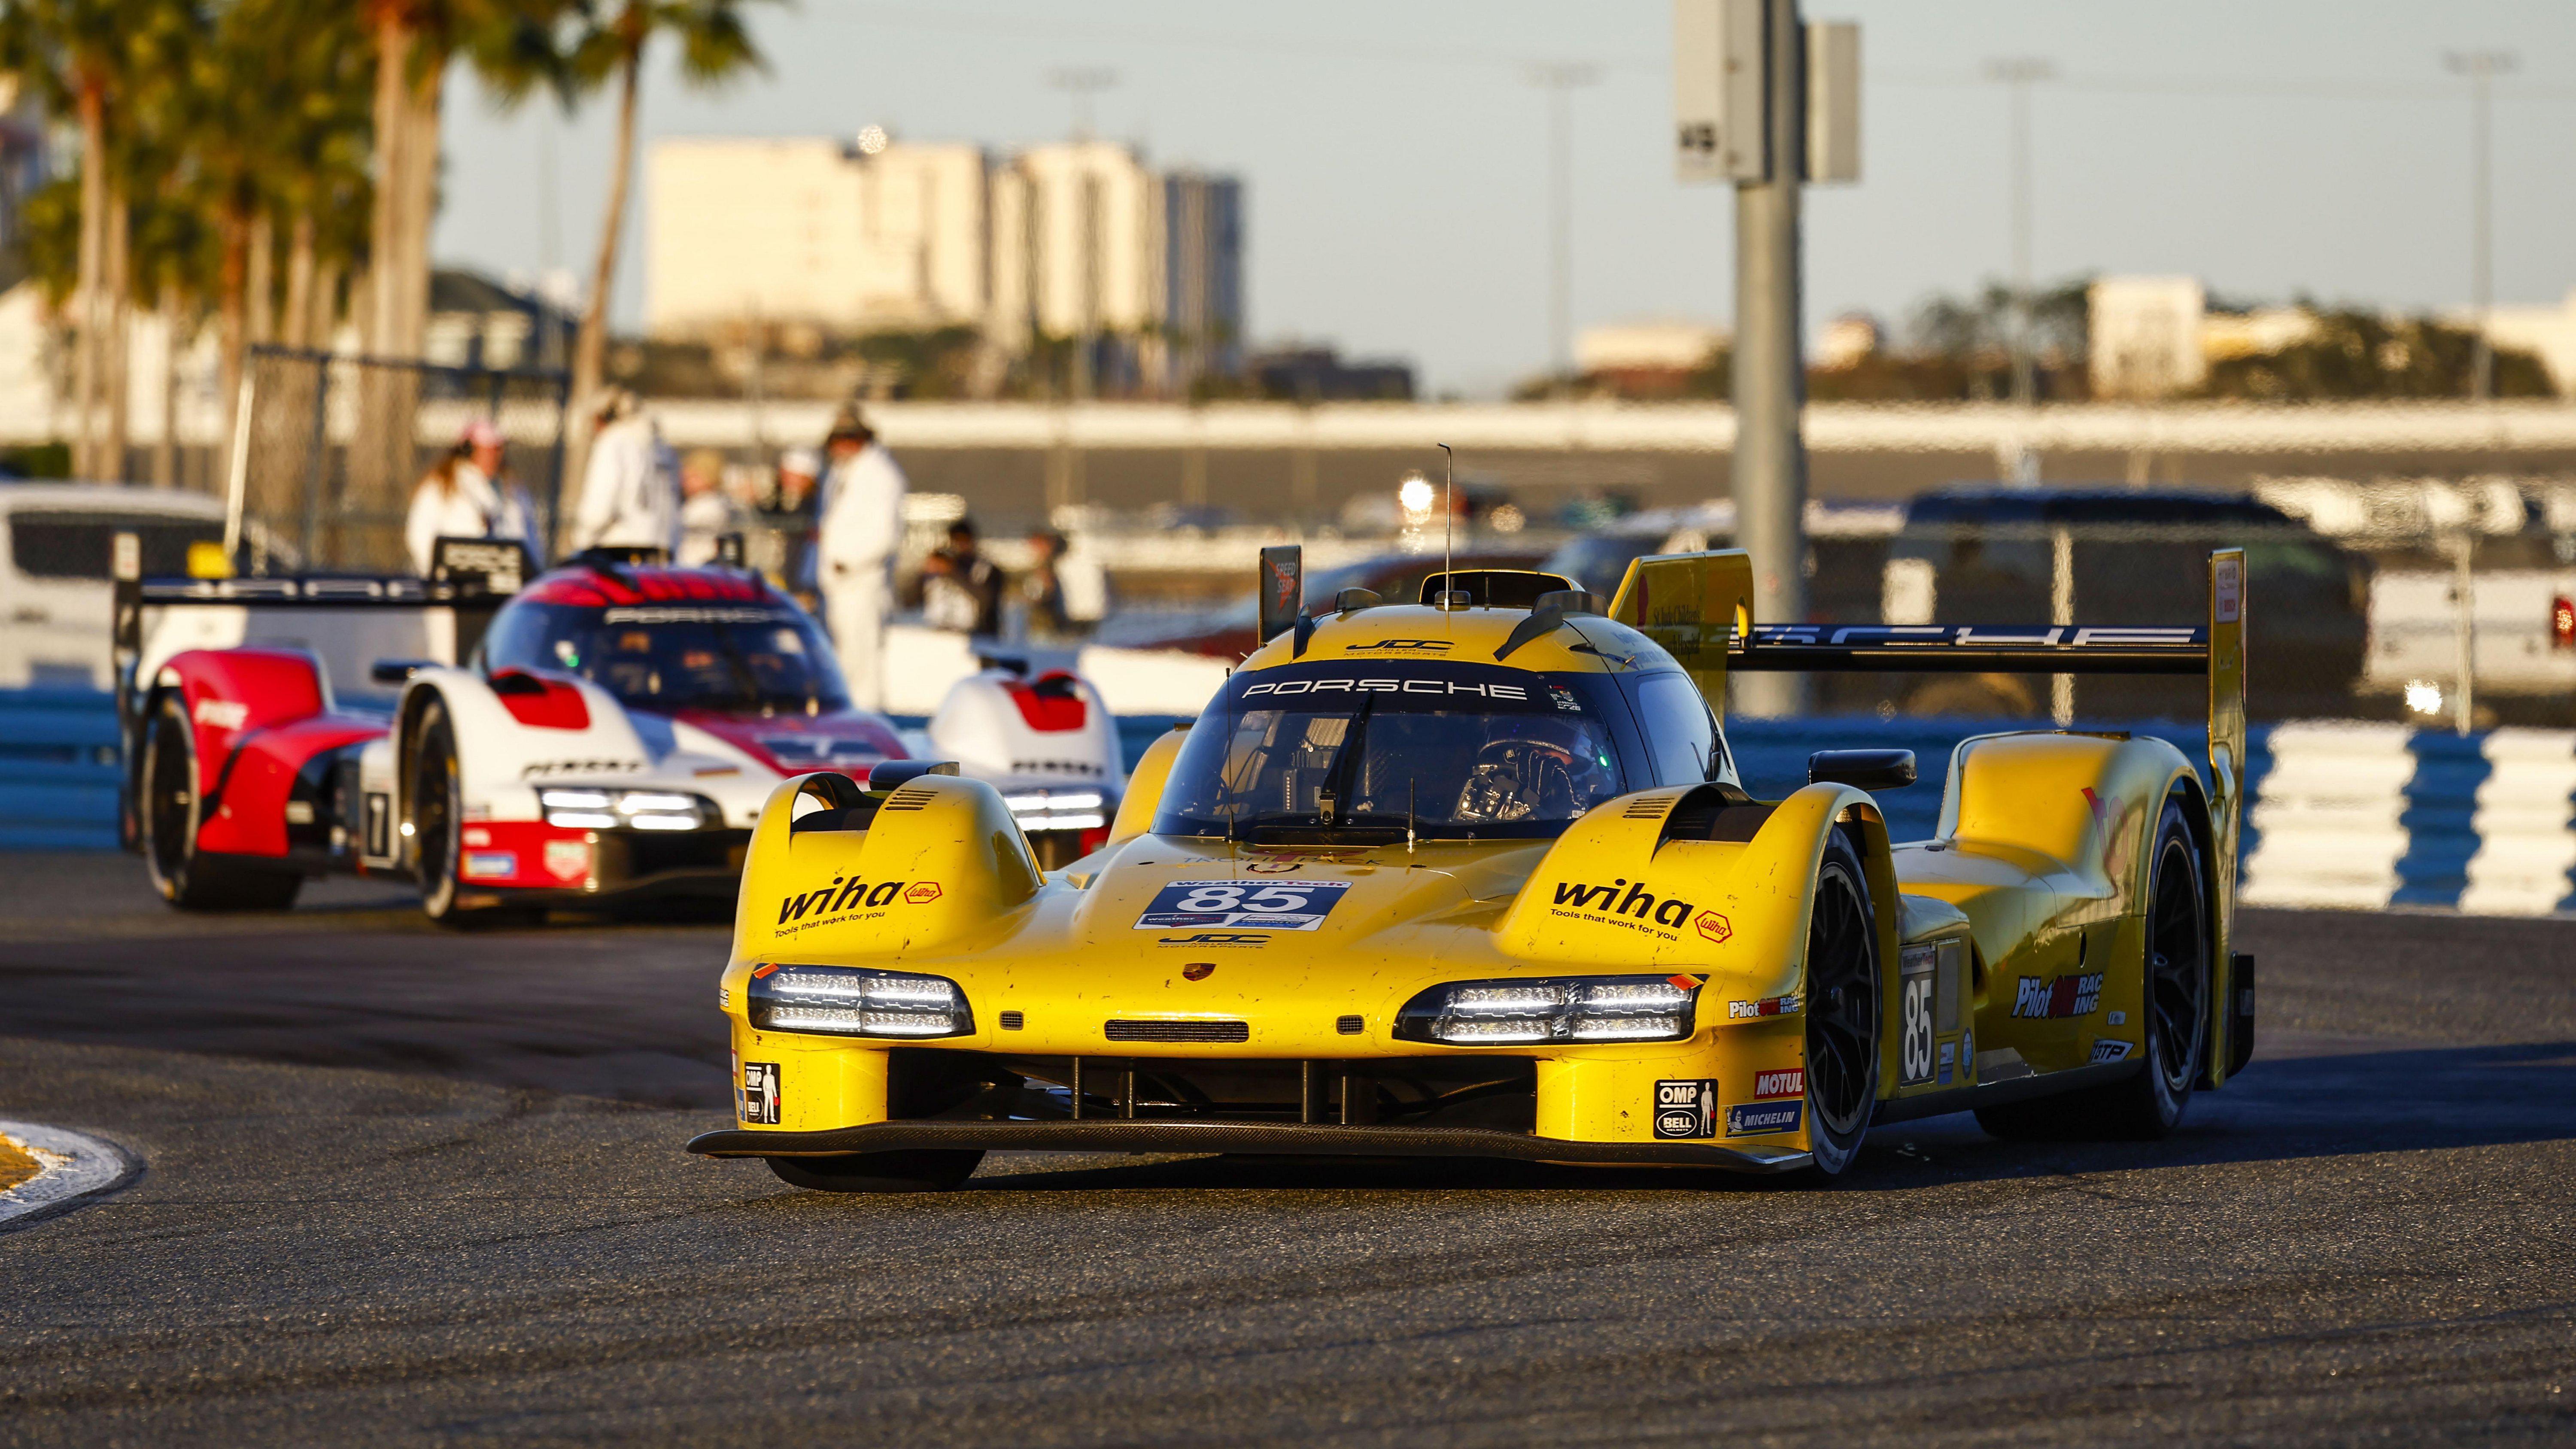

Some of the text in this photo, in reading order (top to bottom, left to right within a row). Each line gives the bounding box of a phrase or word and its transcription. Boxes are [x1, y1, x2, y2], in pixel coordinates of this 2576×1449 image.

[1276, 562, 1296, 577] SPEED
[1242, 679, 1528, 700] PORSCHE
[778, 875, 905, 925] wiha
[1177, 887, 1314, 912] 85
[1553, 878, 1694, 929] wiha
[775, 926, 799, 939] Tools
[801, 920, 820, 931] that
[822, 915, 847, 926] work
[866, 911, 886, 921] you
[1550, 909, 1678, 942] Tools that work for you
[1905, 979, 1931, 1080] 85
[746, 1071, 762, 1086] OMP
[1756, 1072, 1803, 1095] MOTUL
[1659, 1087, 1697, 1103] OMP
[1663, 1117, 1692, 1128] BELL
[1744, 1111, 1795, 1127] MICHELIN
